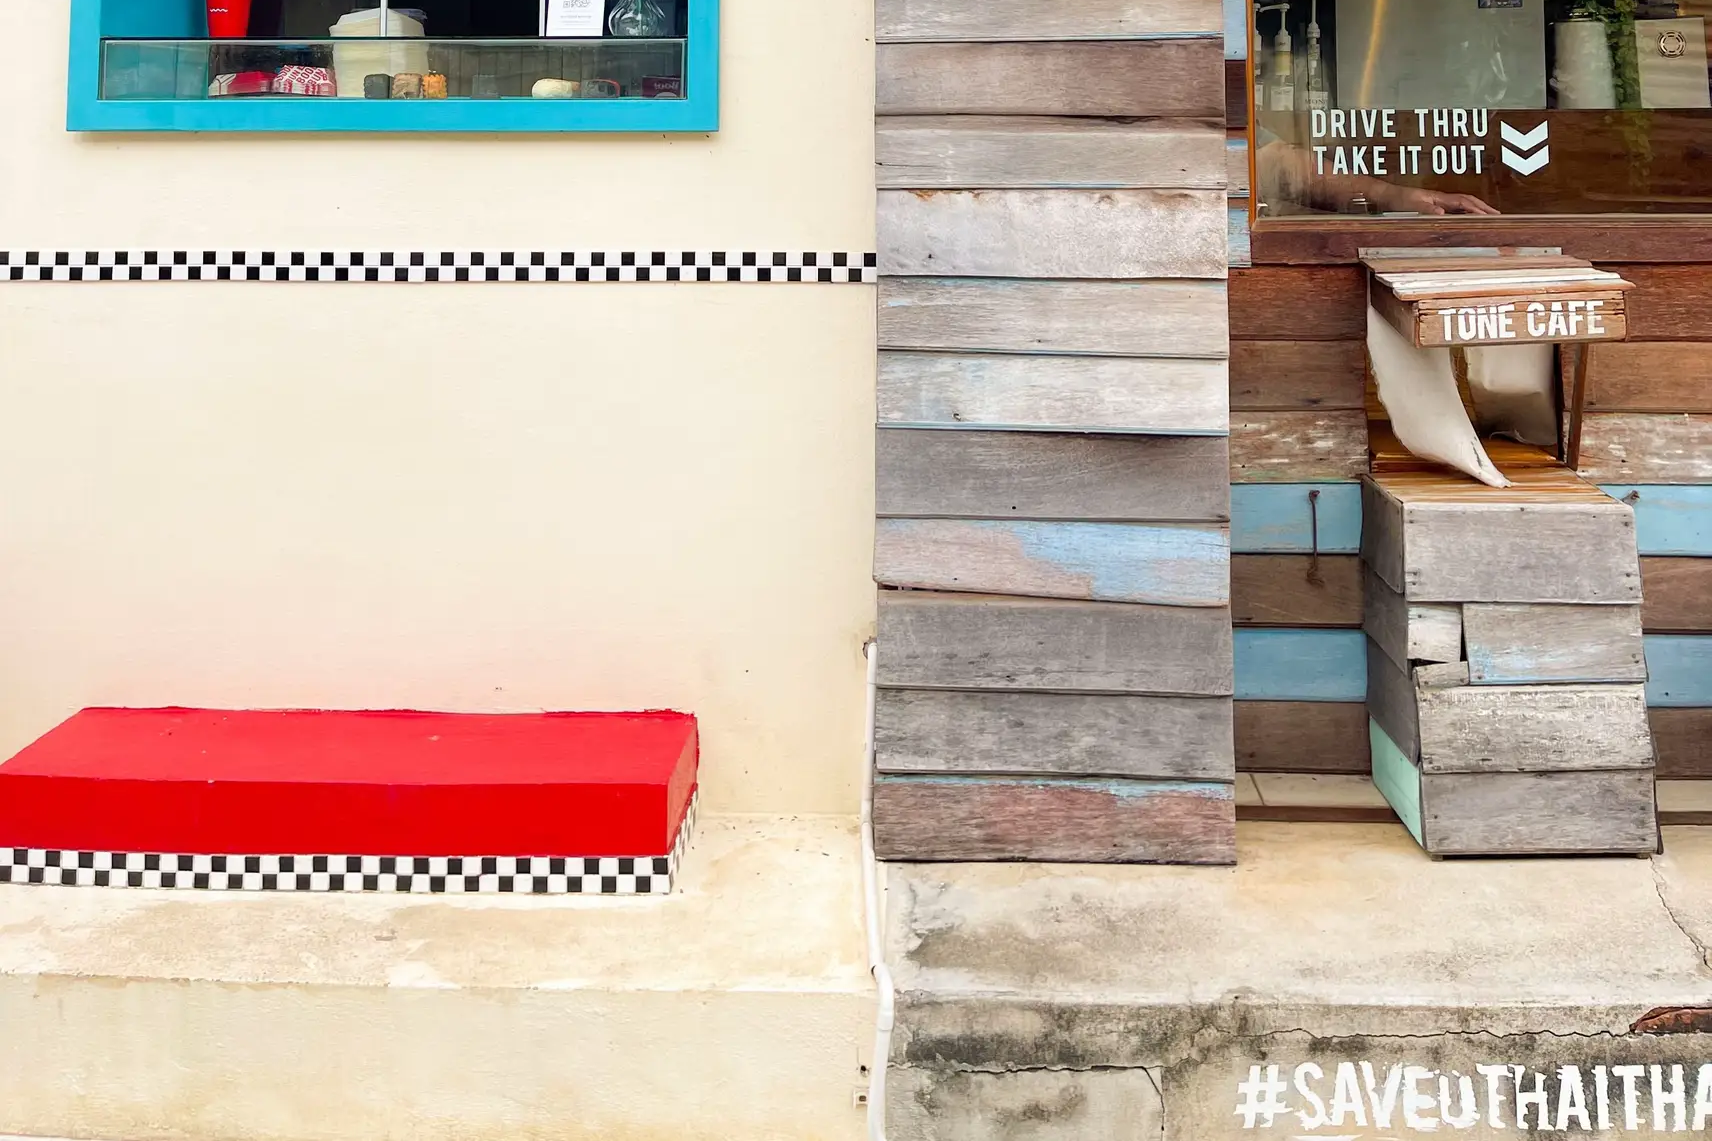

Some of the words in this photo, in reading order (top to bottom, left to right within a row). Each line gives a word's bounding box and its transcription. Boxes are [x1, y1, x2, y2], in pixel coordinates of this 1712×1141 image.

[1311, 108, 1397, 138] DRIVE
[1414, 107, 1489, 138] THRU
[1312, 145, 1388, 175] TAKE
[1400, 145, 1422, 175] IT
[1432, 144, 1486, 175] OUT
[1438, 304, 1517, 341] TONE
[1526, 300, 1605, 338] CAFE
